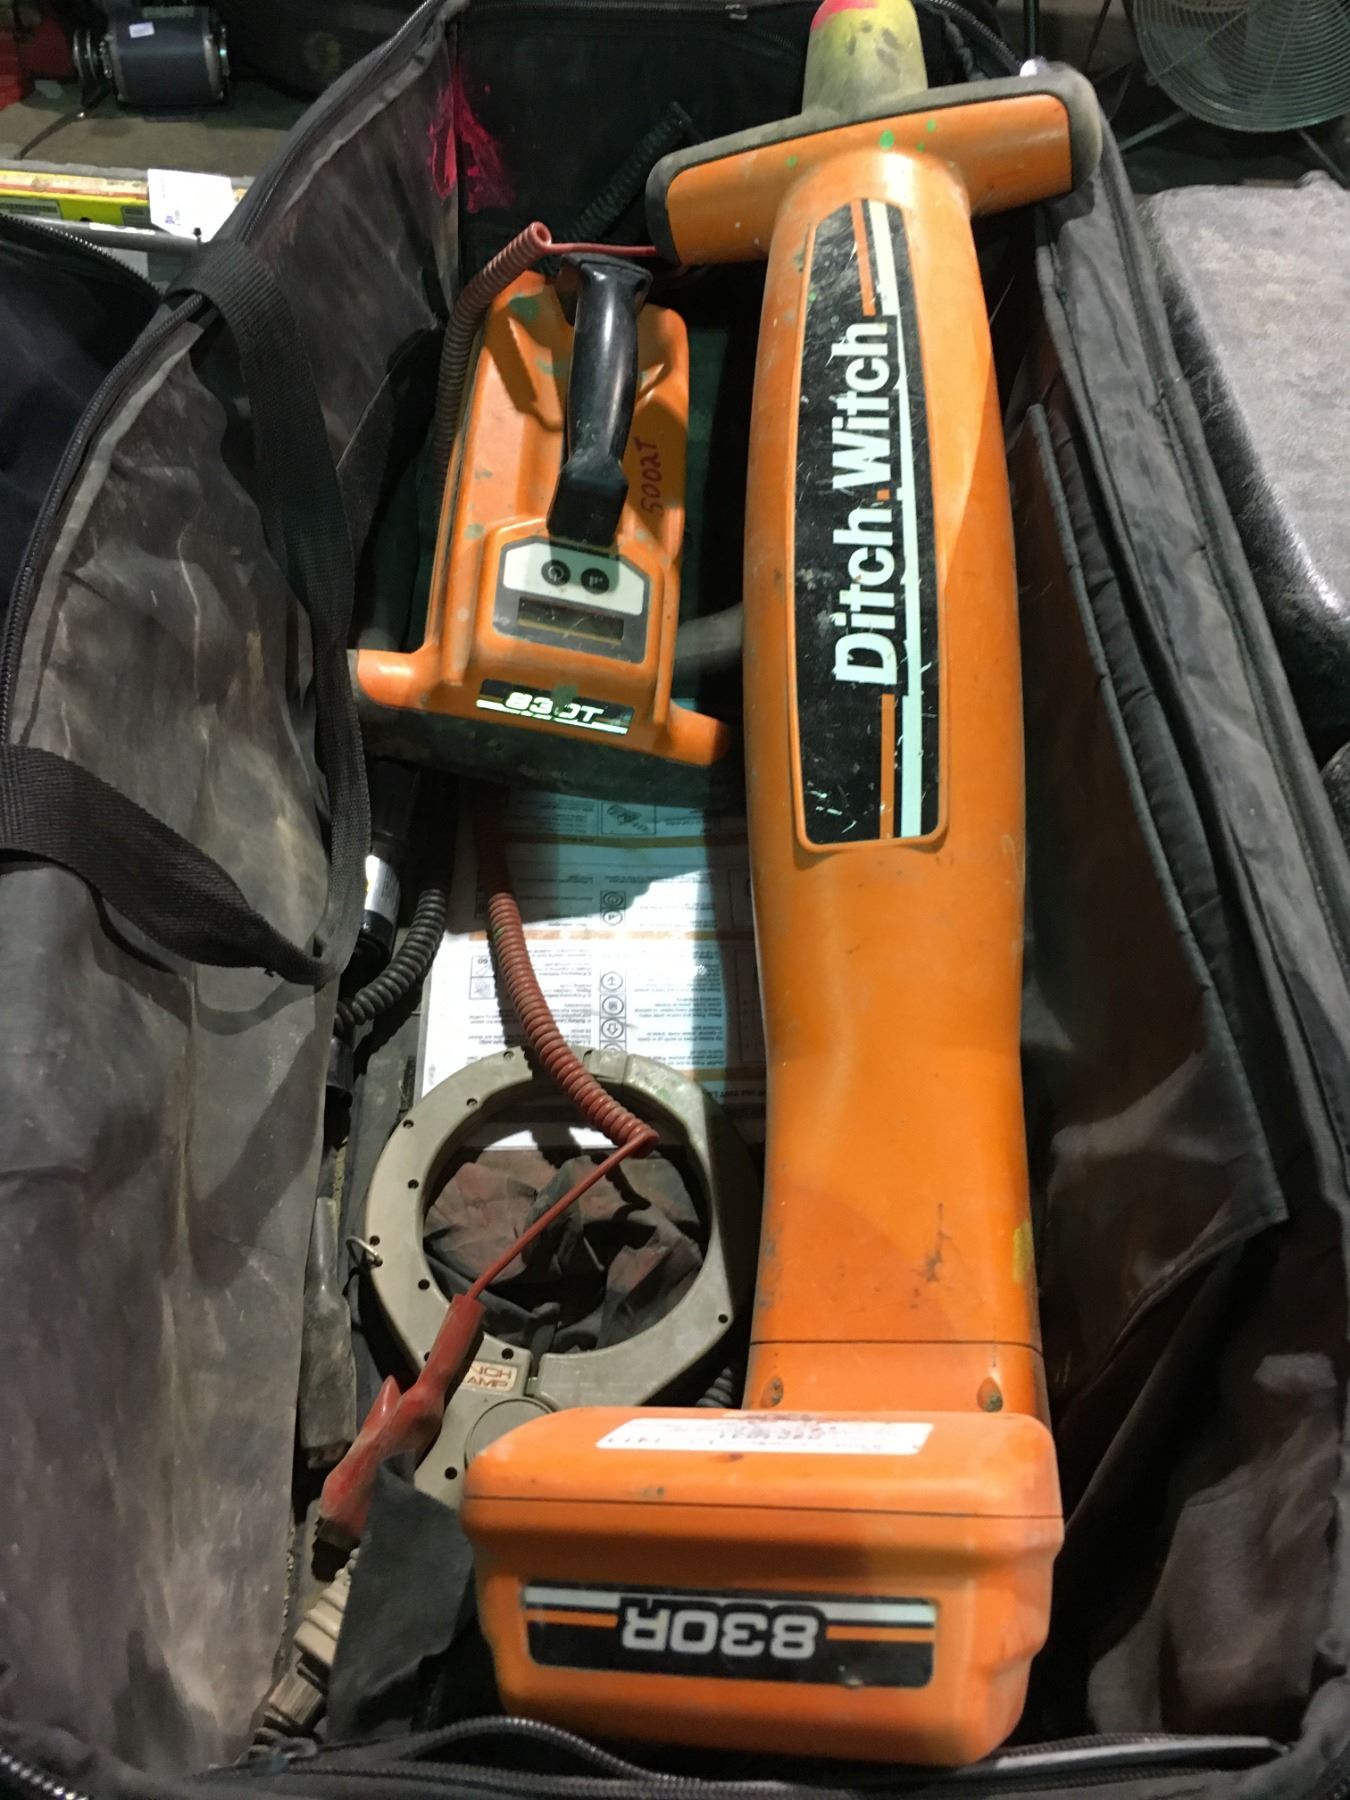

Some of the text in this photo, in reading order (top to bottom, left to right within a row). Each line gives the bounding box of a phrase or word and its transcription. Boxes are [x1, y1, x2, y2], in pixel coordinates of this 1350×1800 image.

[831, 322, 898, 686] Ditch Witch
[622, 1605, 819, 1661] 830R
